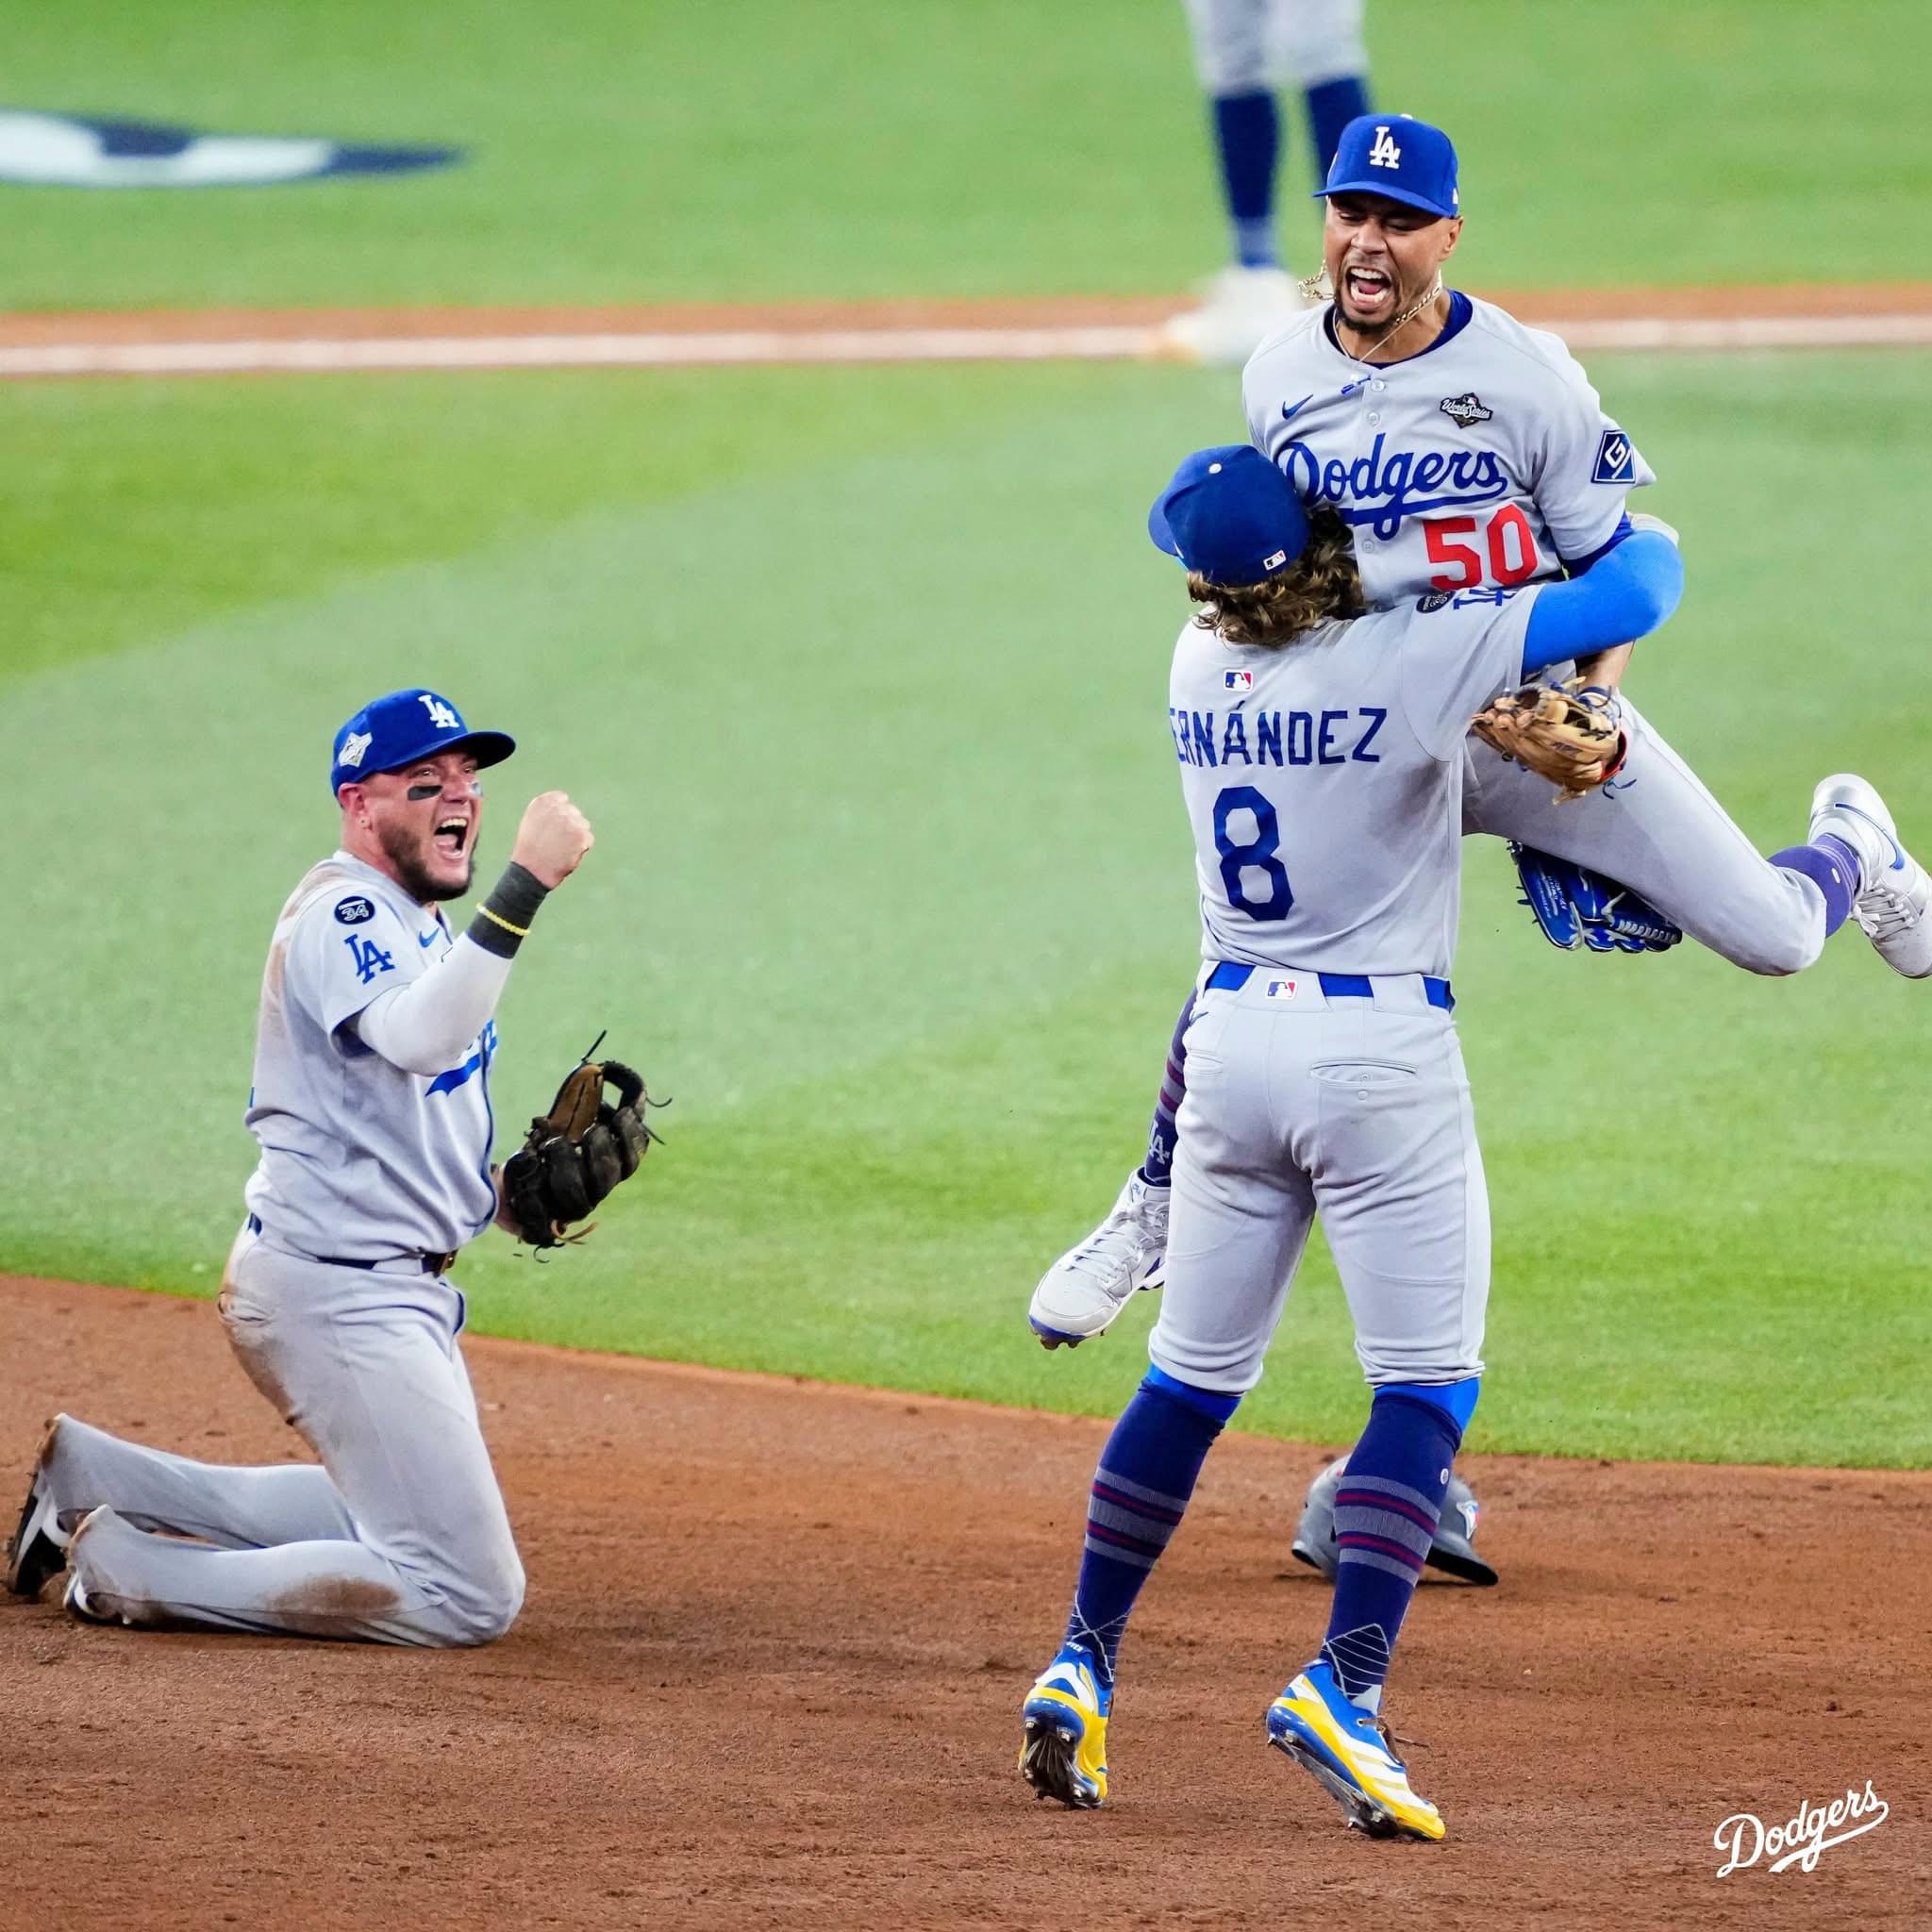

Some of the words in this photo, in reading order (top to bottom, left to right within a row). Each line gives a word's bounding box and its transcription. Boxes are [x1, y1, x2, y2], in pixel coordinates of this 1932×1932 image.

[1370, 126, 1401, 169] LA
[1441, 398, 1468, 413] World
[1463, 405, 1491, 418] Series
[1276, 433, 1507, 541] Dodgers
[1423, 504, 1538, 591] 50
[418, 694, 459, 728] LA
[1213, 786, 1294, 921] 8
[341, 903, 370, 922] 34
[344, 934, 395, 985] LA
